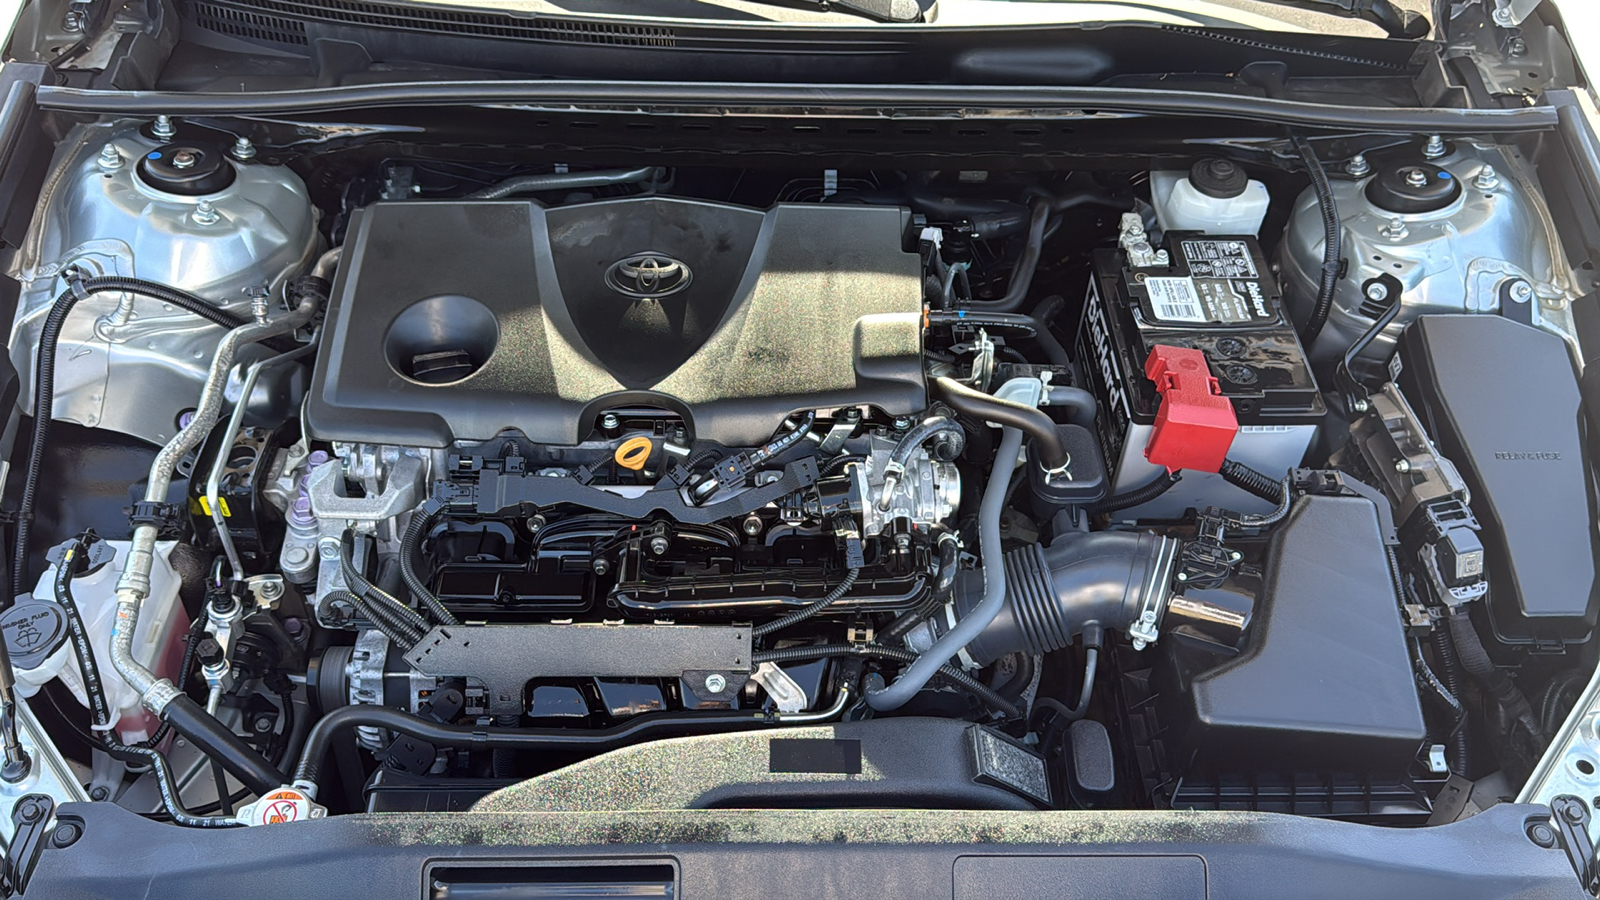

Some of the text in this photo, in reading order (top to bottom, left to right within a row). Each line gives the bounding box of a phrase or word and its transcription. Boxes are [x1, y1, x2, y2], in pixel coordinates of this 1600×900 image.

[1246, 281, 1270, 317] DieHard
[1088, 295, 1119, 412] DieHard
[1494, 451, 1526, 460] RELAY
[1536, 451, 1562, 460] FUSE
